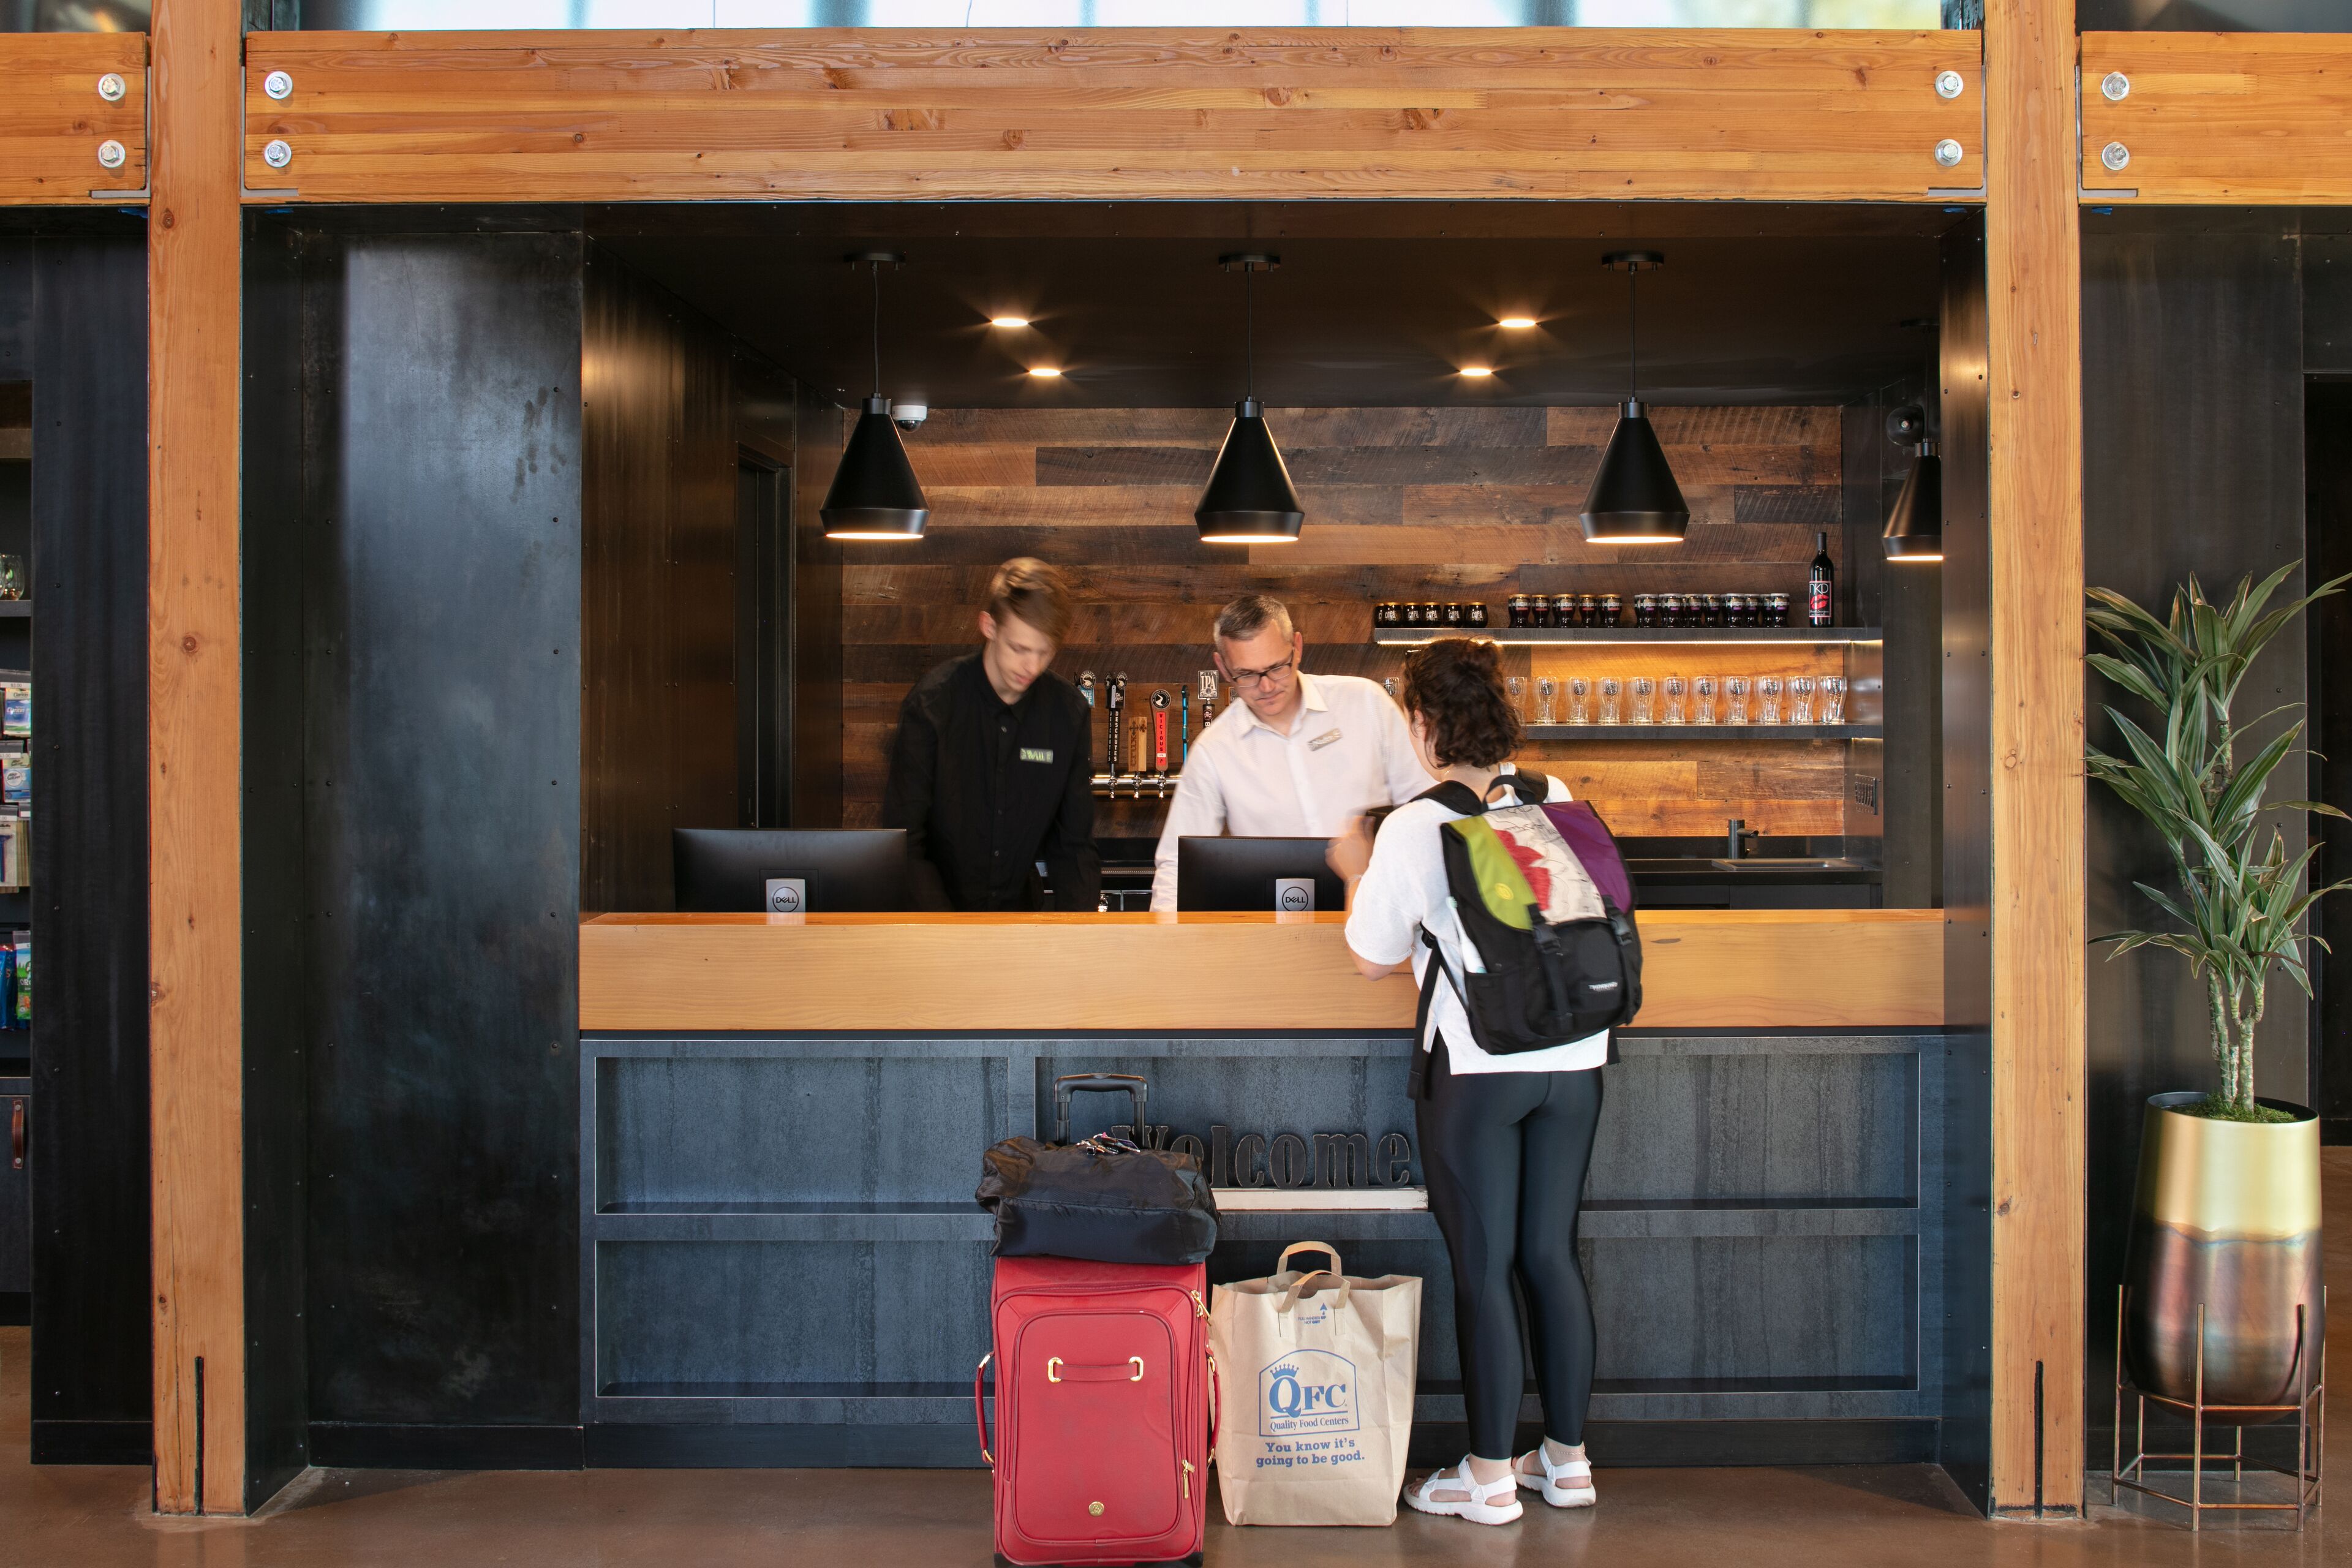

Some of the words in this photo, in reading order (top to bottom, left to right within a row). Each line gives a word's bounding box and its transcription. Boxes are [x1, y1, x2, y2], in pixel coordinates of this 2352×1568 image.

[1200, 676, 1216, 692] IPA
[1269, 1376, 1346, 1418] QFC
[1270, 1420, 1297, 1431] Quality
[1300, 1418, 1318, 1428] Food
[1320, 1417, 1349, 1426] Centers
[1265, 1442, 1292, 1452] You
[1295, 1441, 1331, 1452] know
[1334, 1438, 1355, 1448] it's
[1256, 1455, 1293, 1468] going
[1297, 1455, 1308, 1464] to
[1311, 1453, 1327, 1464] be
[1331, 1450, 1365, 1465] good.
